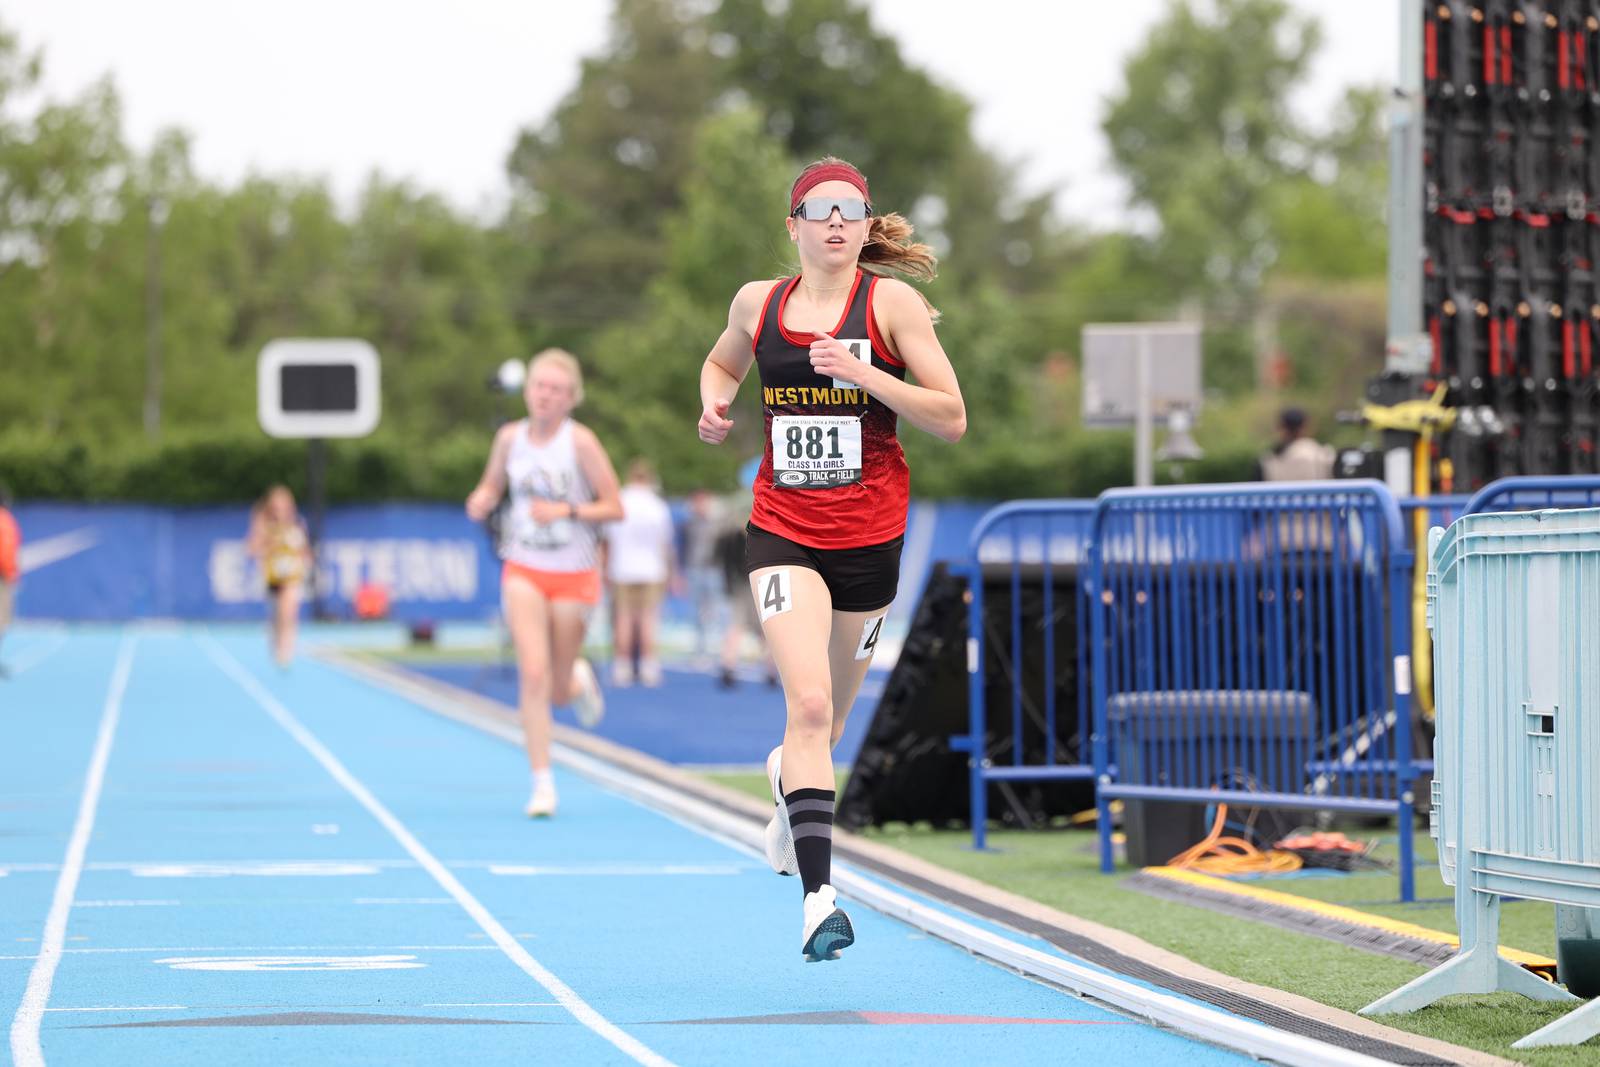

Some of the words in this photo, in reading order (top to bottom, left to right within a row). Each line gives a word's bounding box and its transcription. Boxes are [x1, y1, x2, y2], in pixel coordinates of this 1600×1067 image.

[763, 387, 869, 405] WESTMONT
[786, 426, 843, 459] 881
[788, 460, 810, 469] CLASS
[813, 460, 822, 469] 1A
[823, 460, 845, 468] GIRLS
[809, 471, 829, 481] TRACK
[837, 470, 854, 479] FIELD
[210, 540, 478, 602] ETERN
[764, 573, 785, 612] 4
[863, 616, 883, 654] 4
